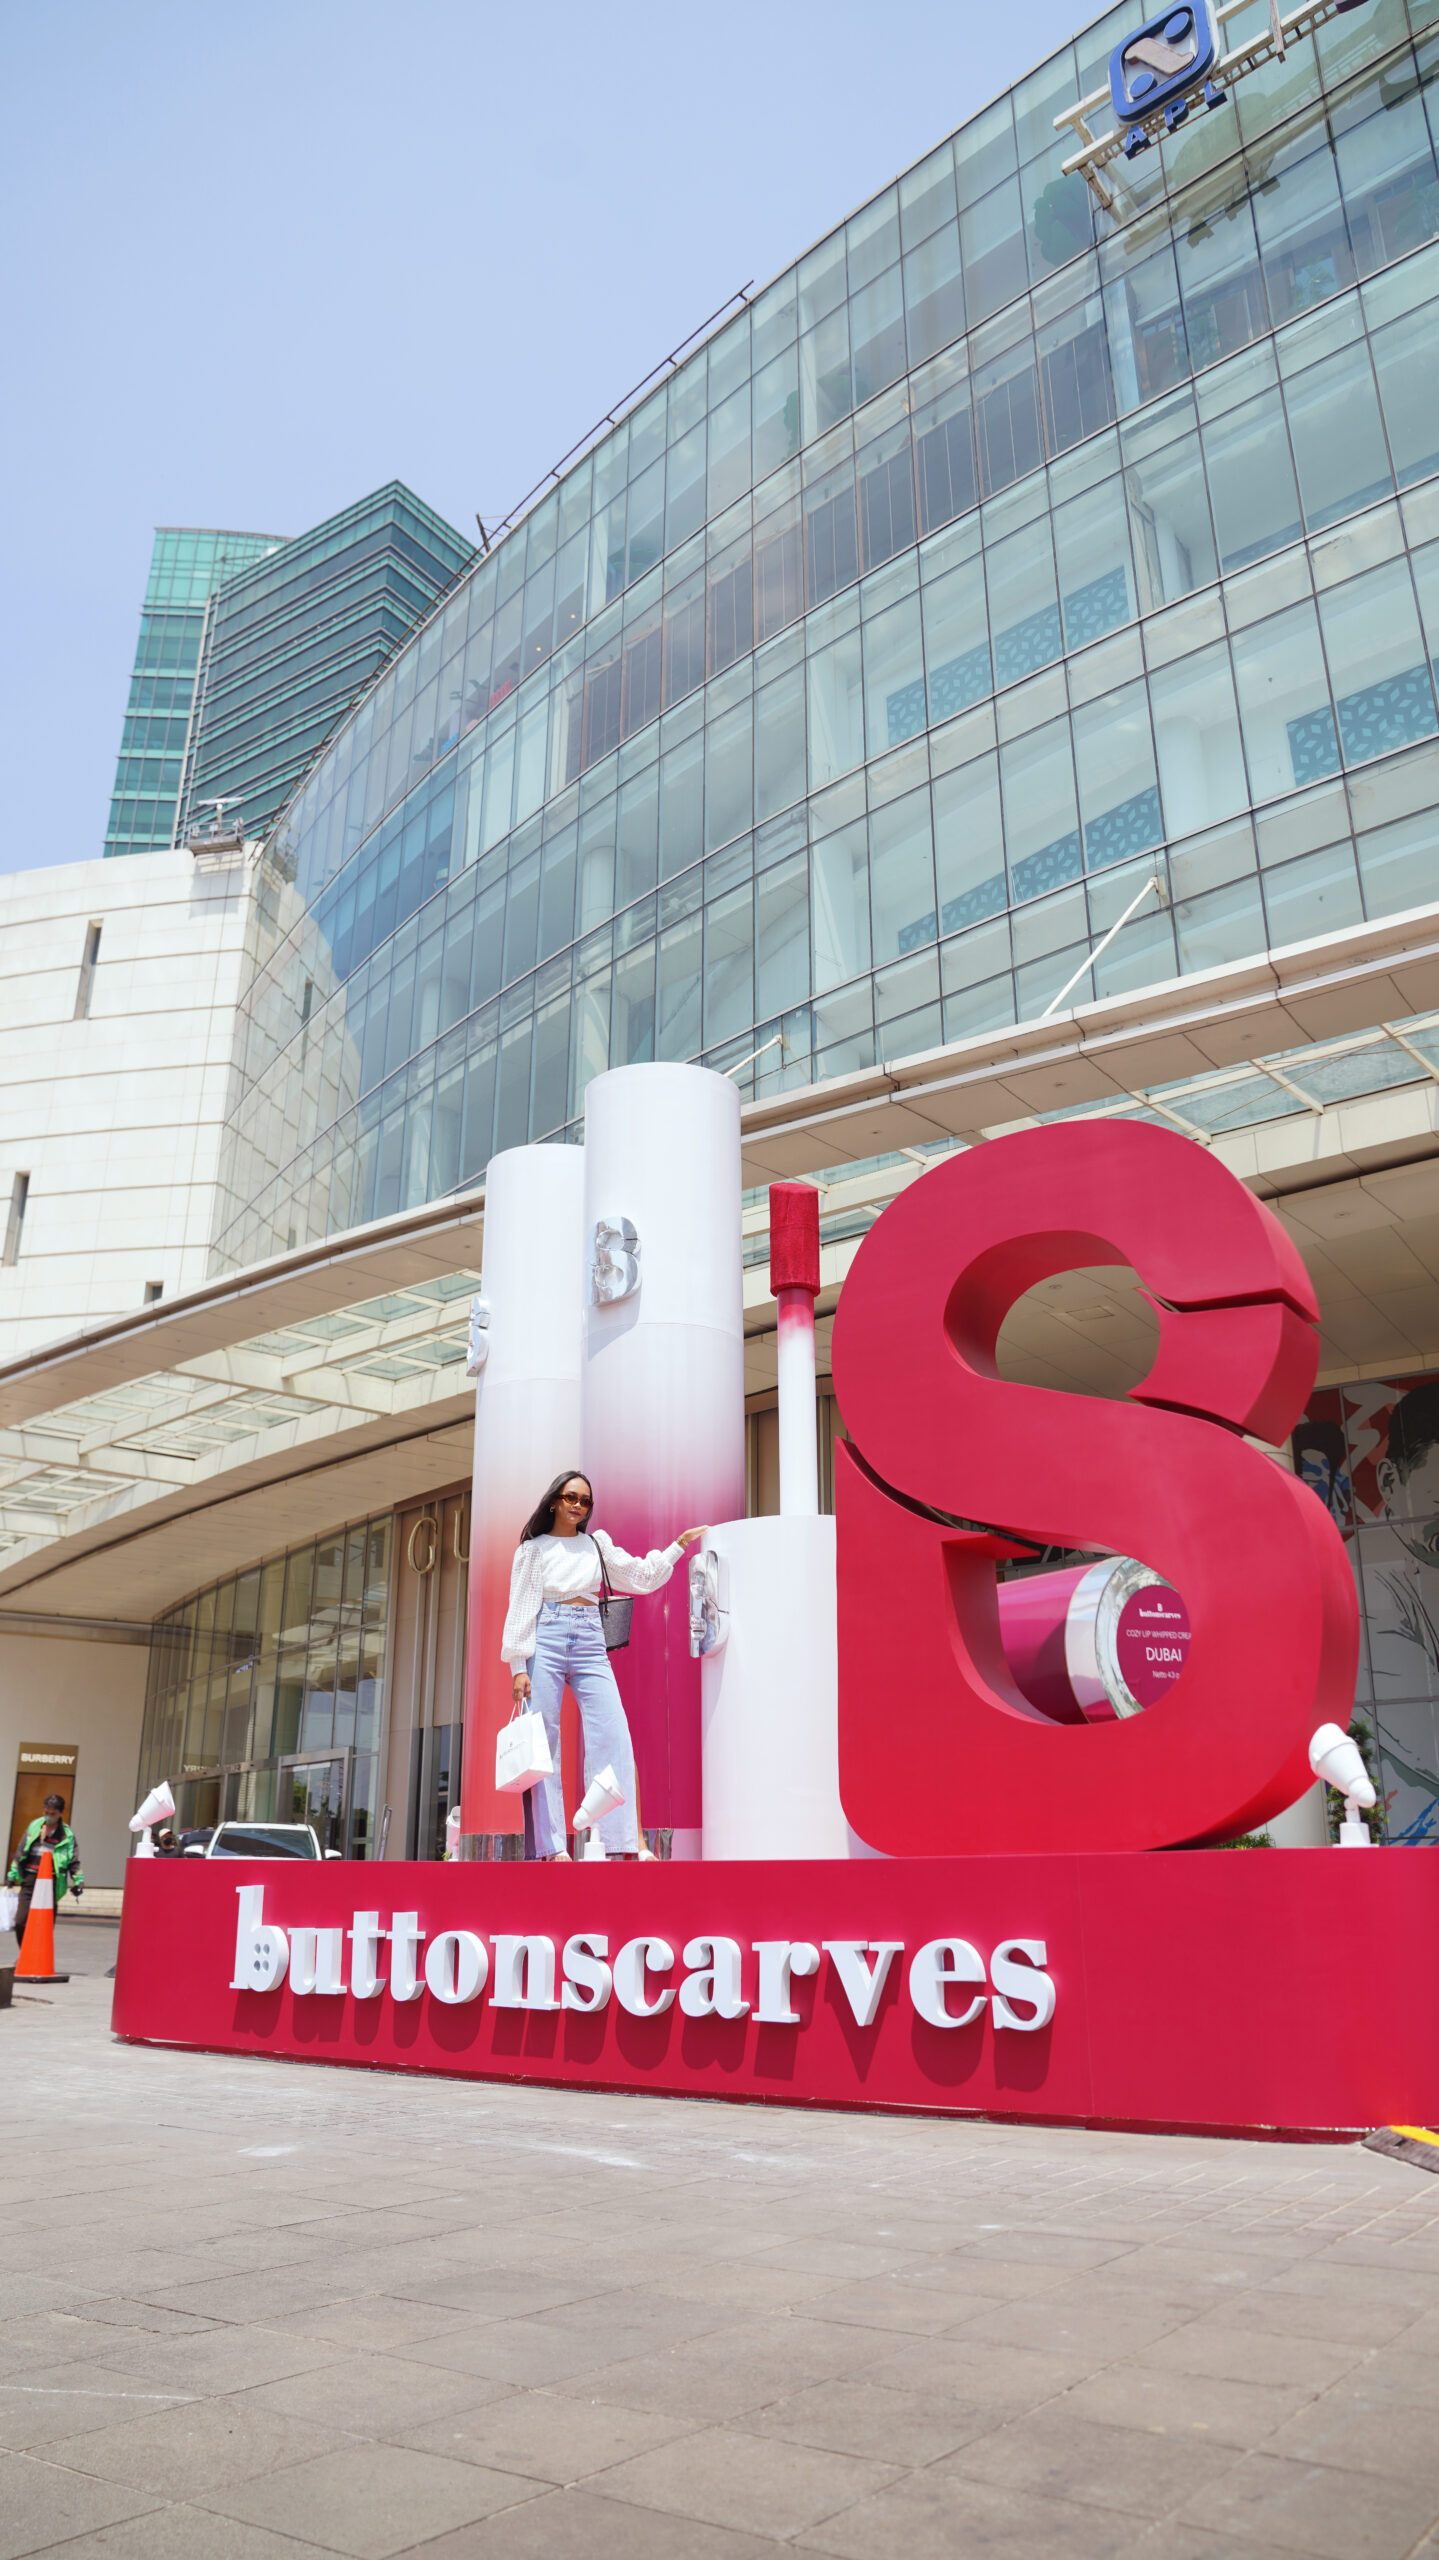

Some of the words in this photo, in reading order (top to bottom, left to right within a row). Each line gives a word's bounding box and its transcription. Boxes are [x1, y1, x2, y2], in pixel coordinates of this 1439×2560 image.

[1125, 80, 1227, 160] APL
[1146, 1647, 1182, 1662] DUBAI
[21, 1753, 75, 1764] BURBERRY
[229, 1884, 1058, 2031] buttonscarves
